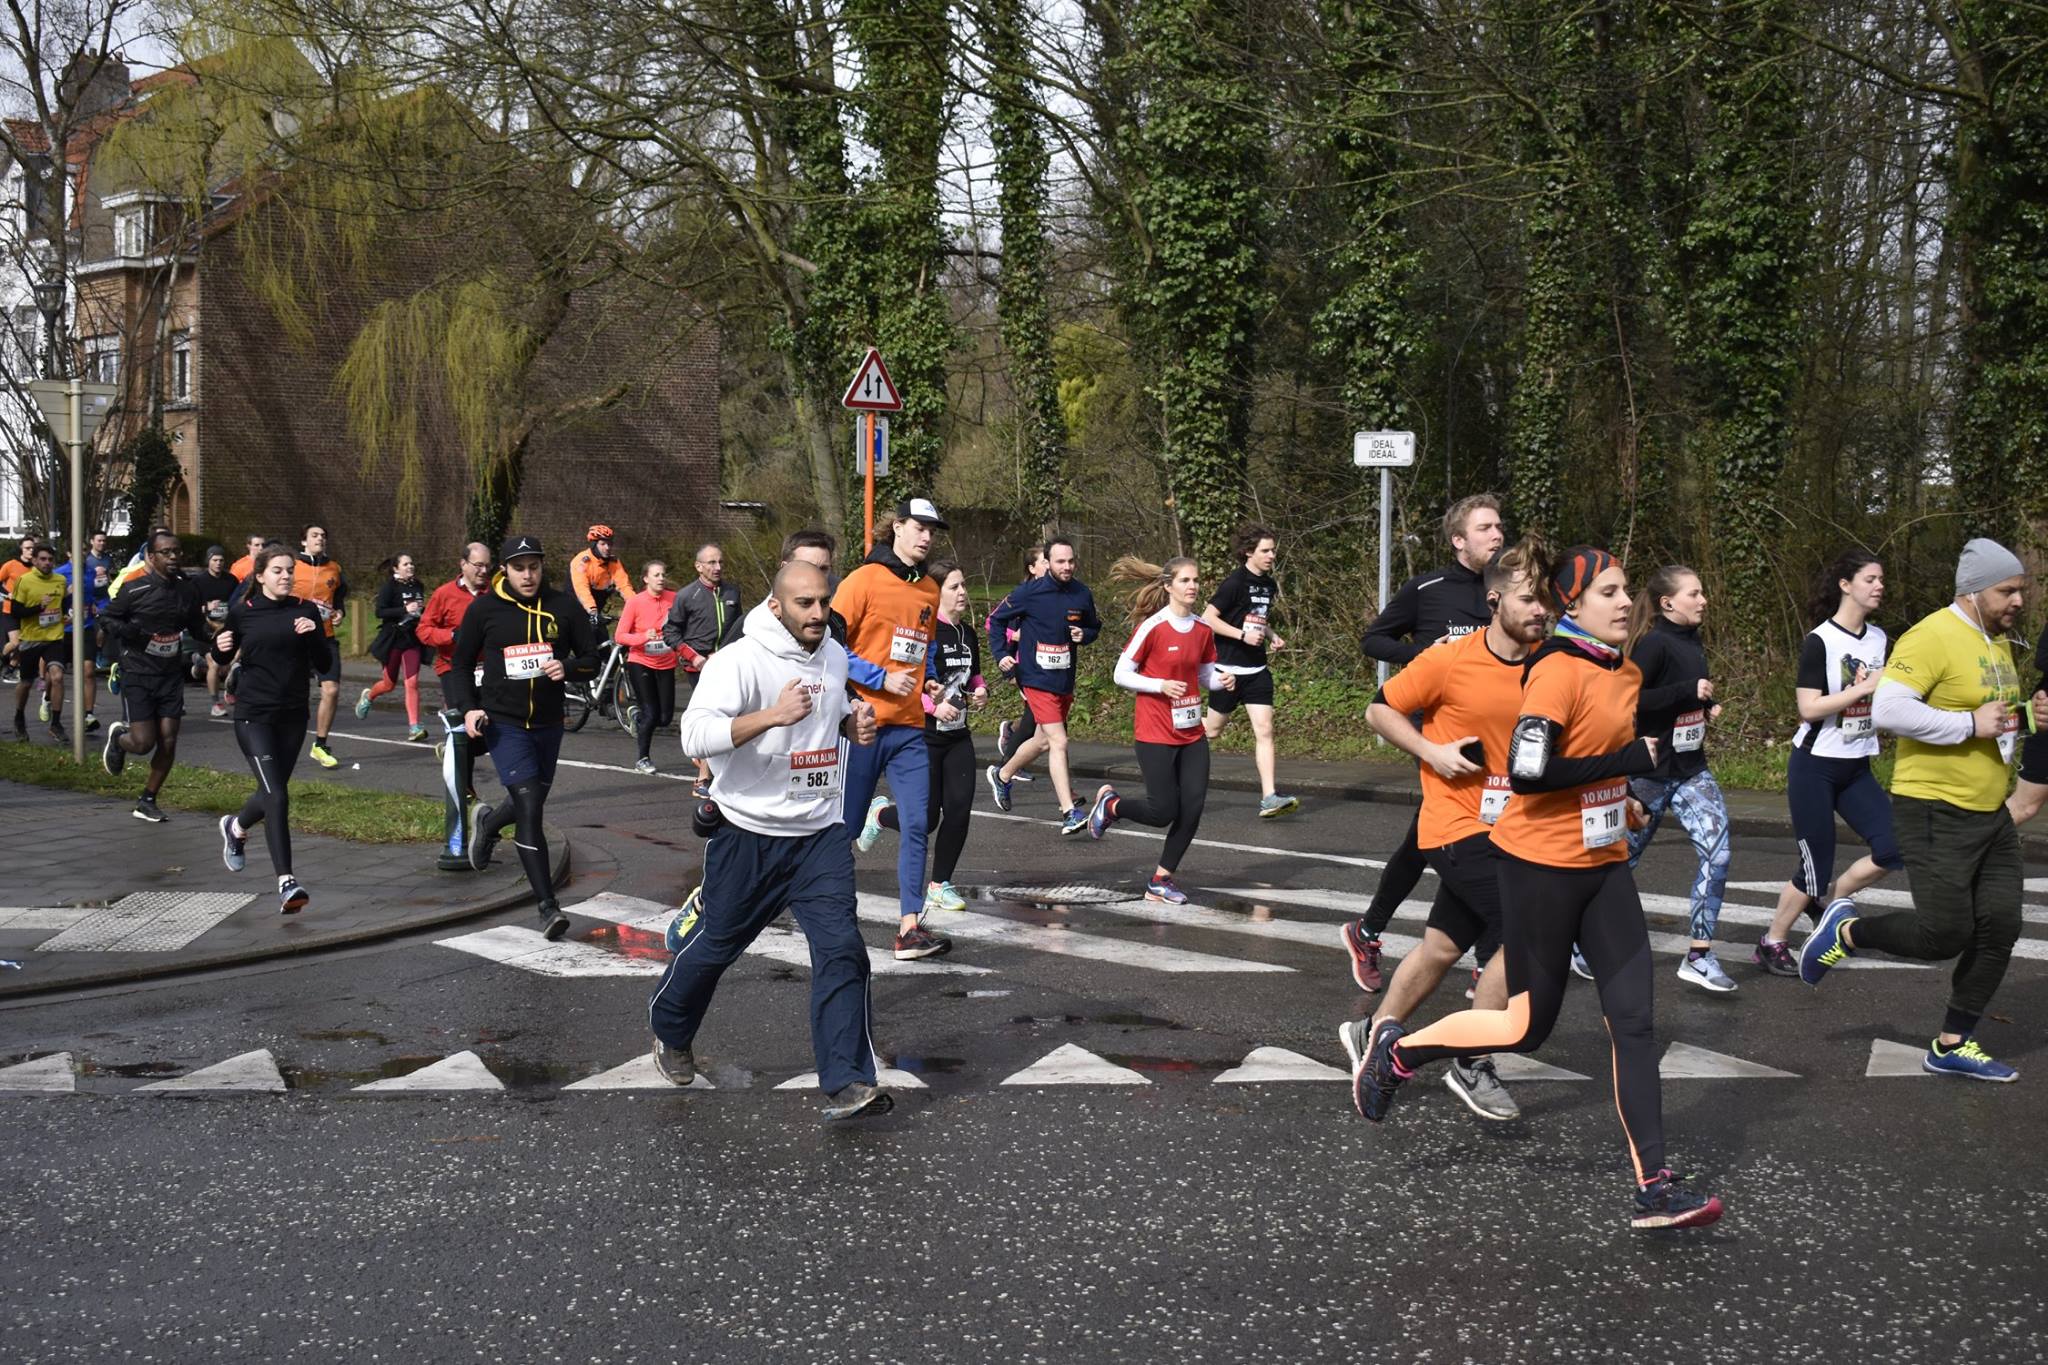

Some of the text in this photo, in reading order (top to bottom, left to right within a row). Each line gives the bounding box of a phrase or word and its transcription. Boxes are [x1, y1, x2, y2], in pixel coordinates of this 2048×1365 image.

[1371, 440, 1395, 449] IDEAL
[1368, 450, 1397, 459] IDEAAL
[895, 627, 904, 635] 10
[904, 629, 915, 637] KM
[515, 646, 529, 655] KM
[1048, 655, 1061, 663] 162
[521, 658, 540, 671] 351
[1187, 709, 1196, 719] 26
[793, 751, 837, 765] 10 KM ALMA
[807, 771, 829, 787] 582
[1487, 776, 1511, 787] 10 K
[1582, 791, 1596, 804] 10
[1597, 788, 1611, 802] KM
[1603, 809, 1619, 829] 110
